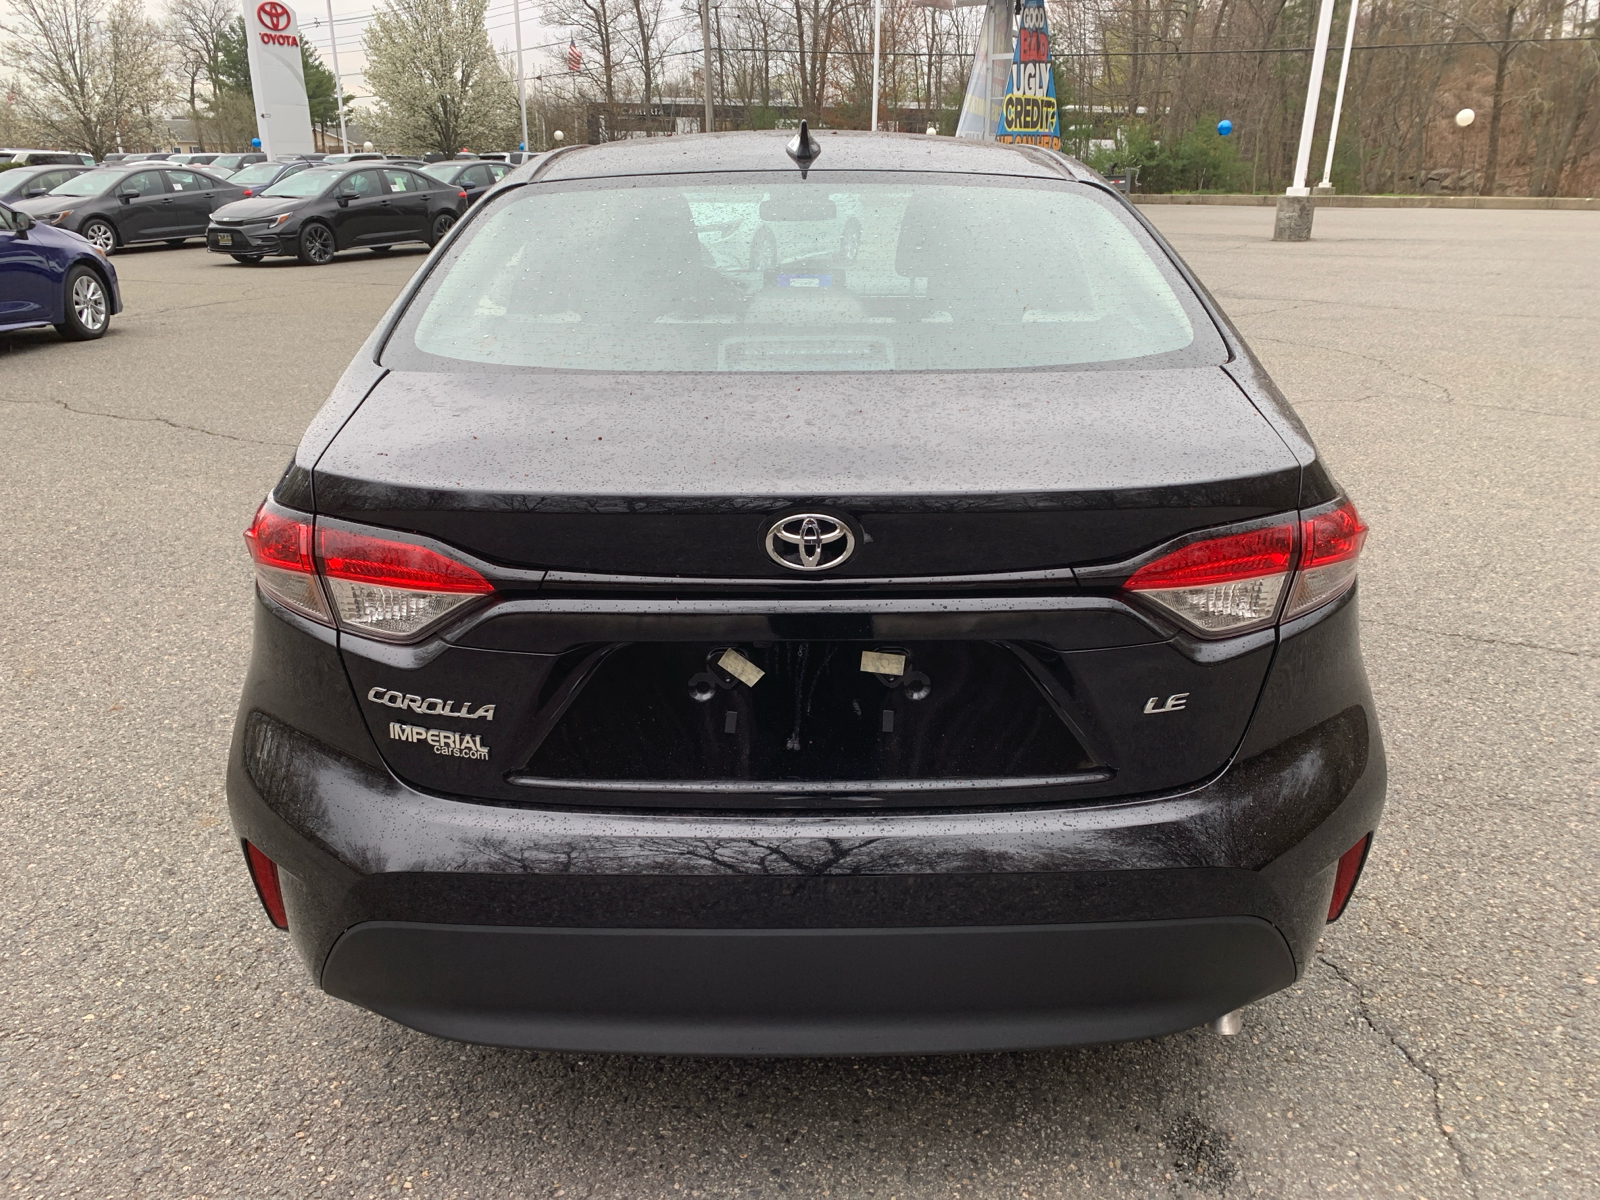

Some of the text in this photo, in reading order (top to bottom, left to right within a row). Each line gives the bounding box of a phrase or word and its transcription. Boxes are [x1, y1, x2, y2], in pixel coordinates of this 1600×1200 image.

[1023, 7, 1045, 28] GOOD
[259, 32, 299, 47] OYOTA
[1020, 28, 1048, 62] BAD
[1012, 62, 1051, 97] UGLY
[1003, 94, 1057, 132] CREDIT?
[367, 686, 497, 721] COROLLA
[1143, 692, 1190, 714] LE
[389, 722, 490, 752] IMPERIAL
[434, 745, 489, 761] cars.com
